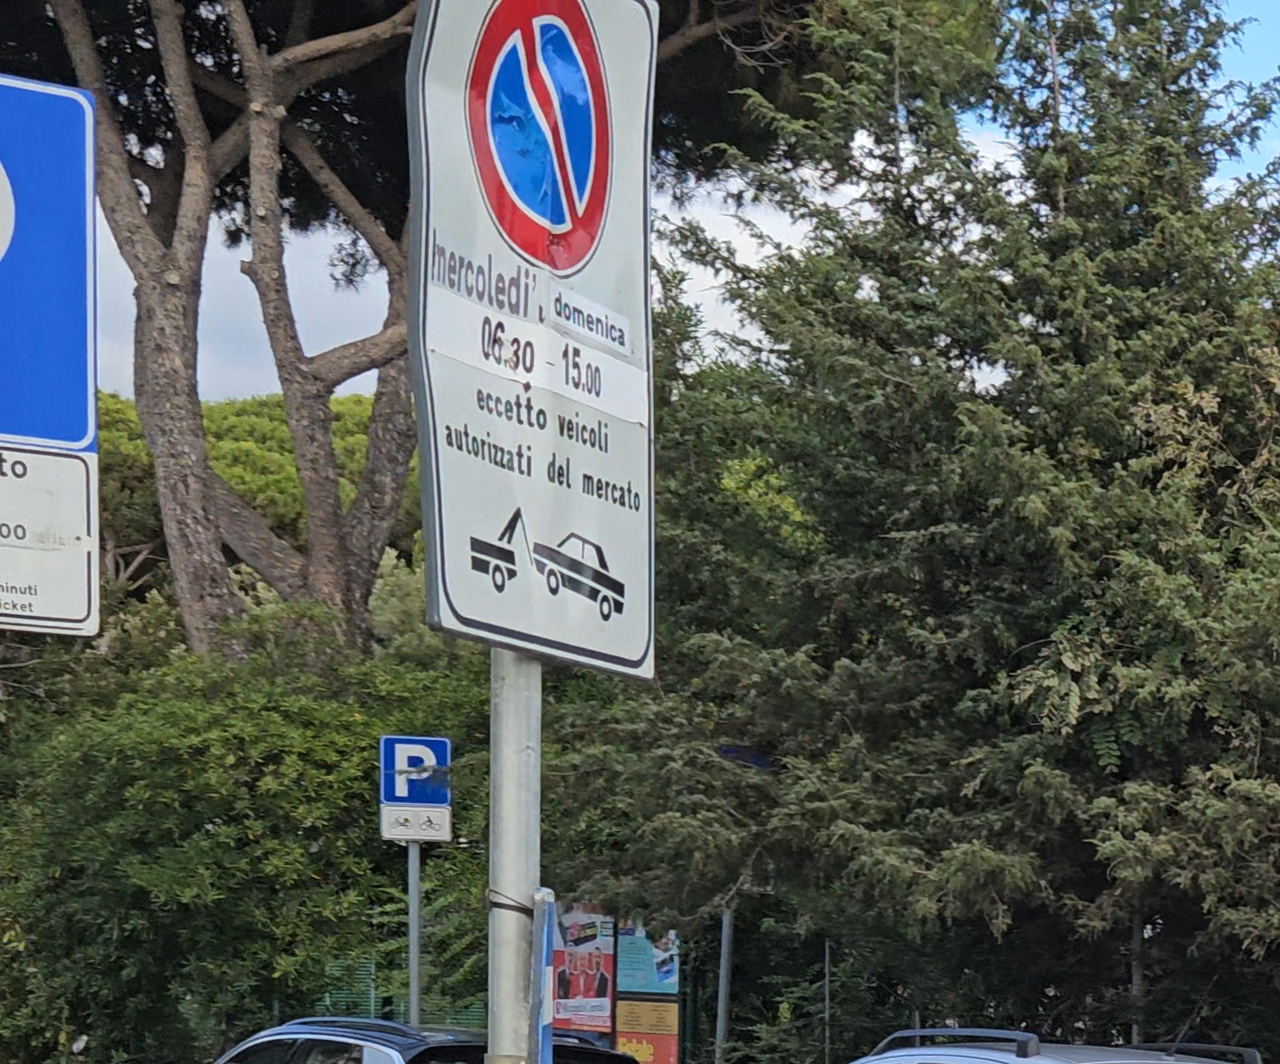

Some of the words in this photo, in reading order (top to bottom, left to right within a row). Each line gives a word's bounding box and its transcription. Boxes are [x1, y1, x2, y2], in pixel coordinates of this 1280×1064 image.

[554, 291, 626, 347] domenica
[562, 342, 602, 398] 15.00
[476, 388, 547, 431] eccetto
[557, 412, 609, 454] veicoli
[445, 423, 533, 477] autorizzati
[547, 452, 572, 489] del
[582, 472, 641, 512] mercato
[395, 744, 437, 797] P
